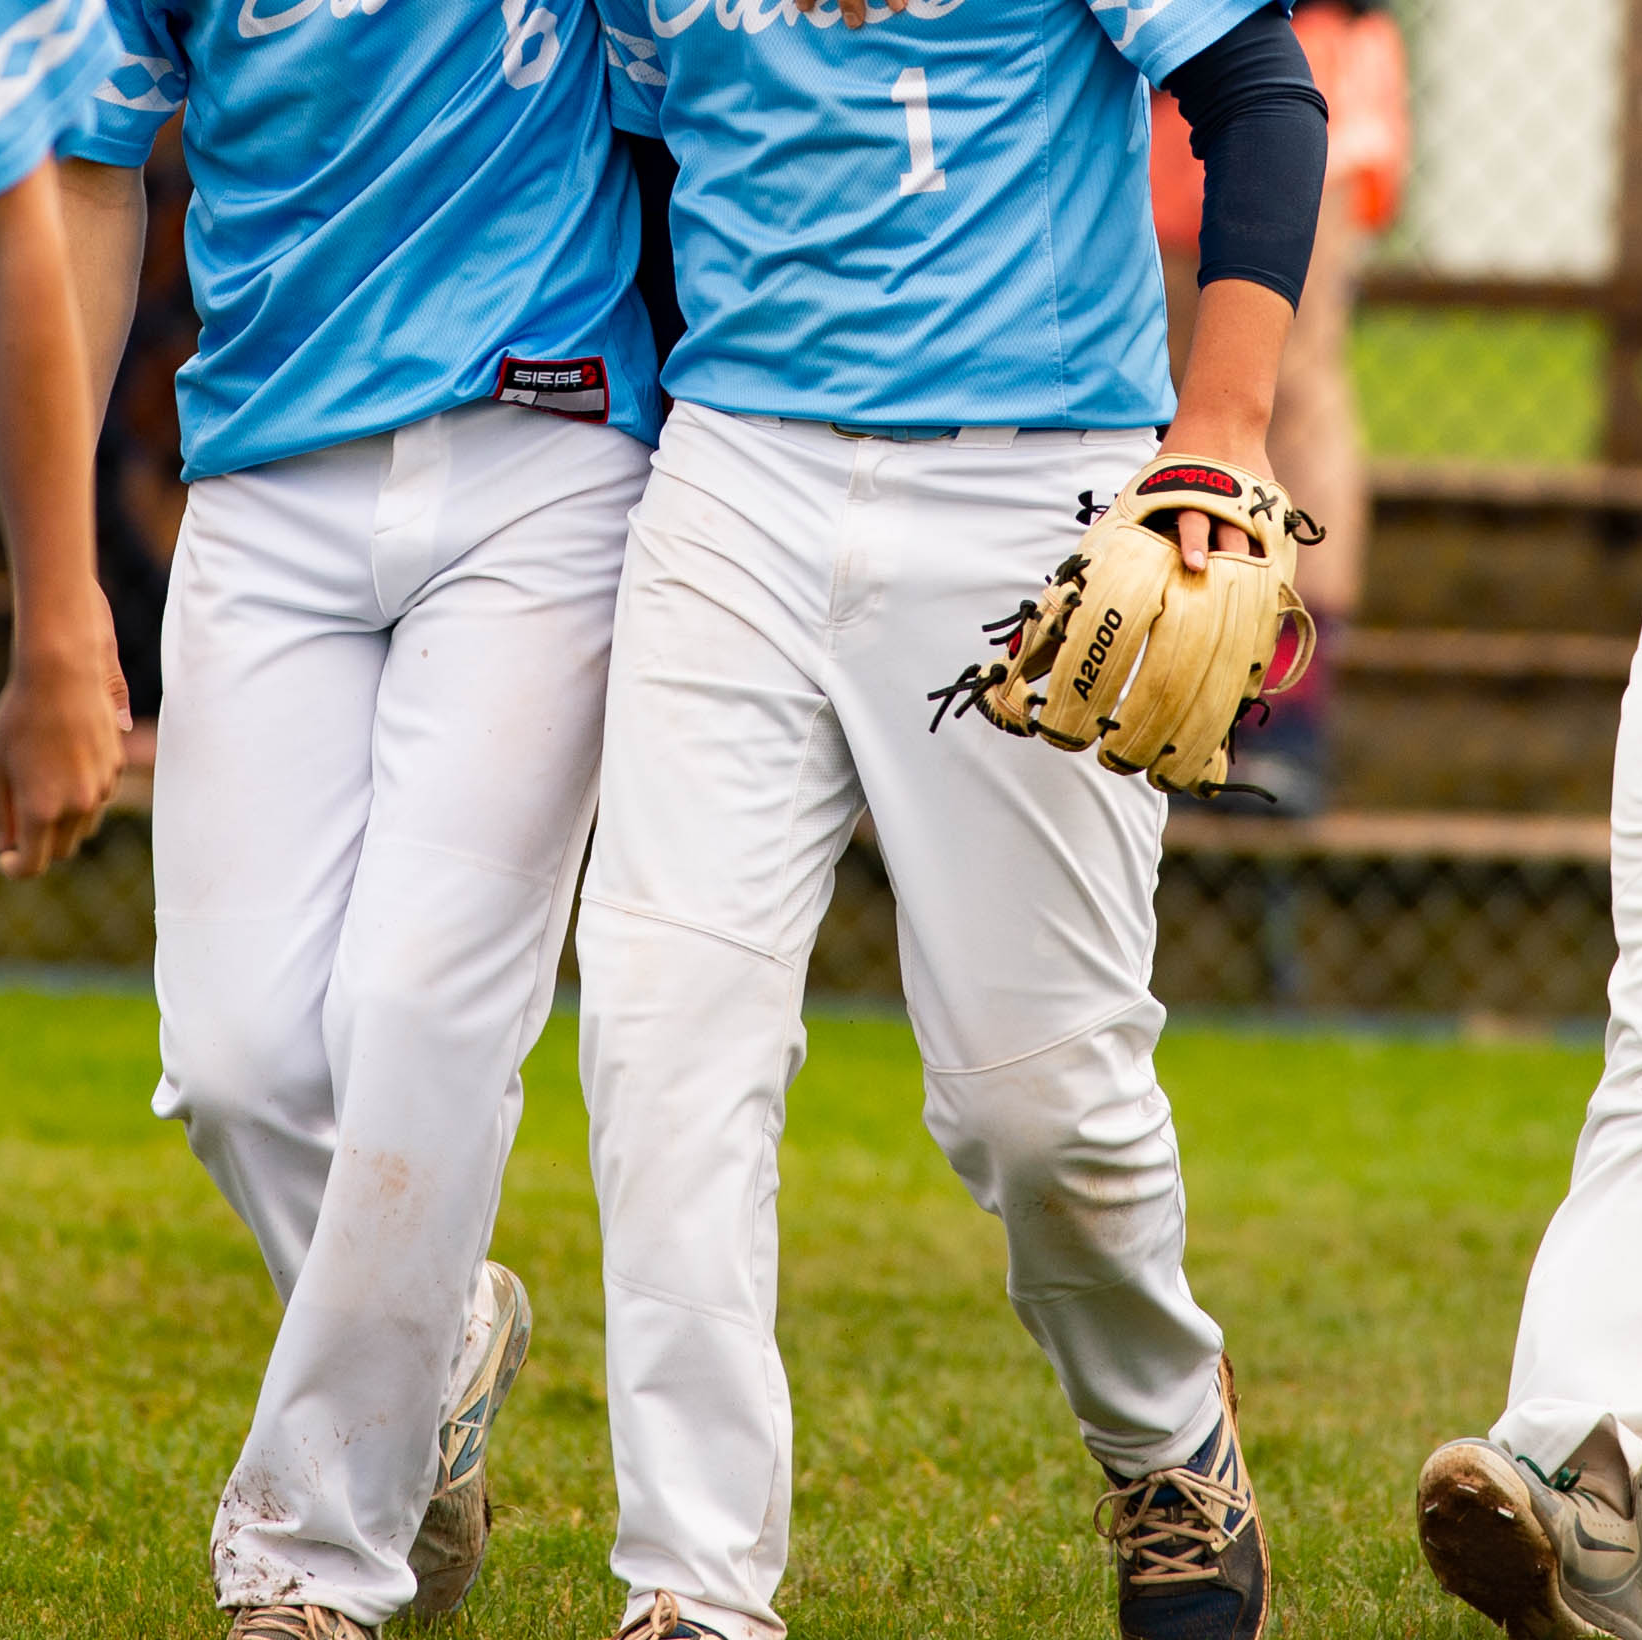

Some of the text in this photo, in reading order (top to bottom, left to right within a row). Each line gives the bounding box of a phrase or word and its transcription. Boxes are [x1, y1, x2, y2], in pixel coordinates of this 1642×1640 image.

[891, 67, 946, 196] 1
[513, 370, 582, 384] SIEGE
[1072, 607, 1123, 701] A2000
